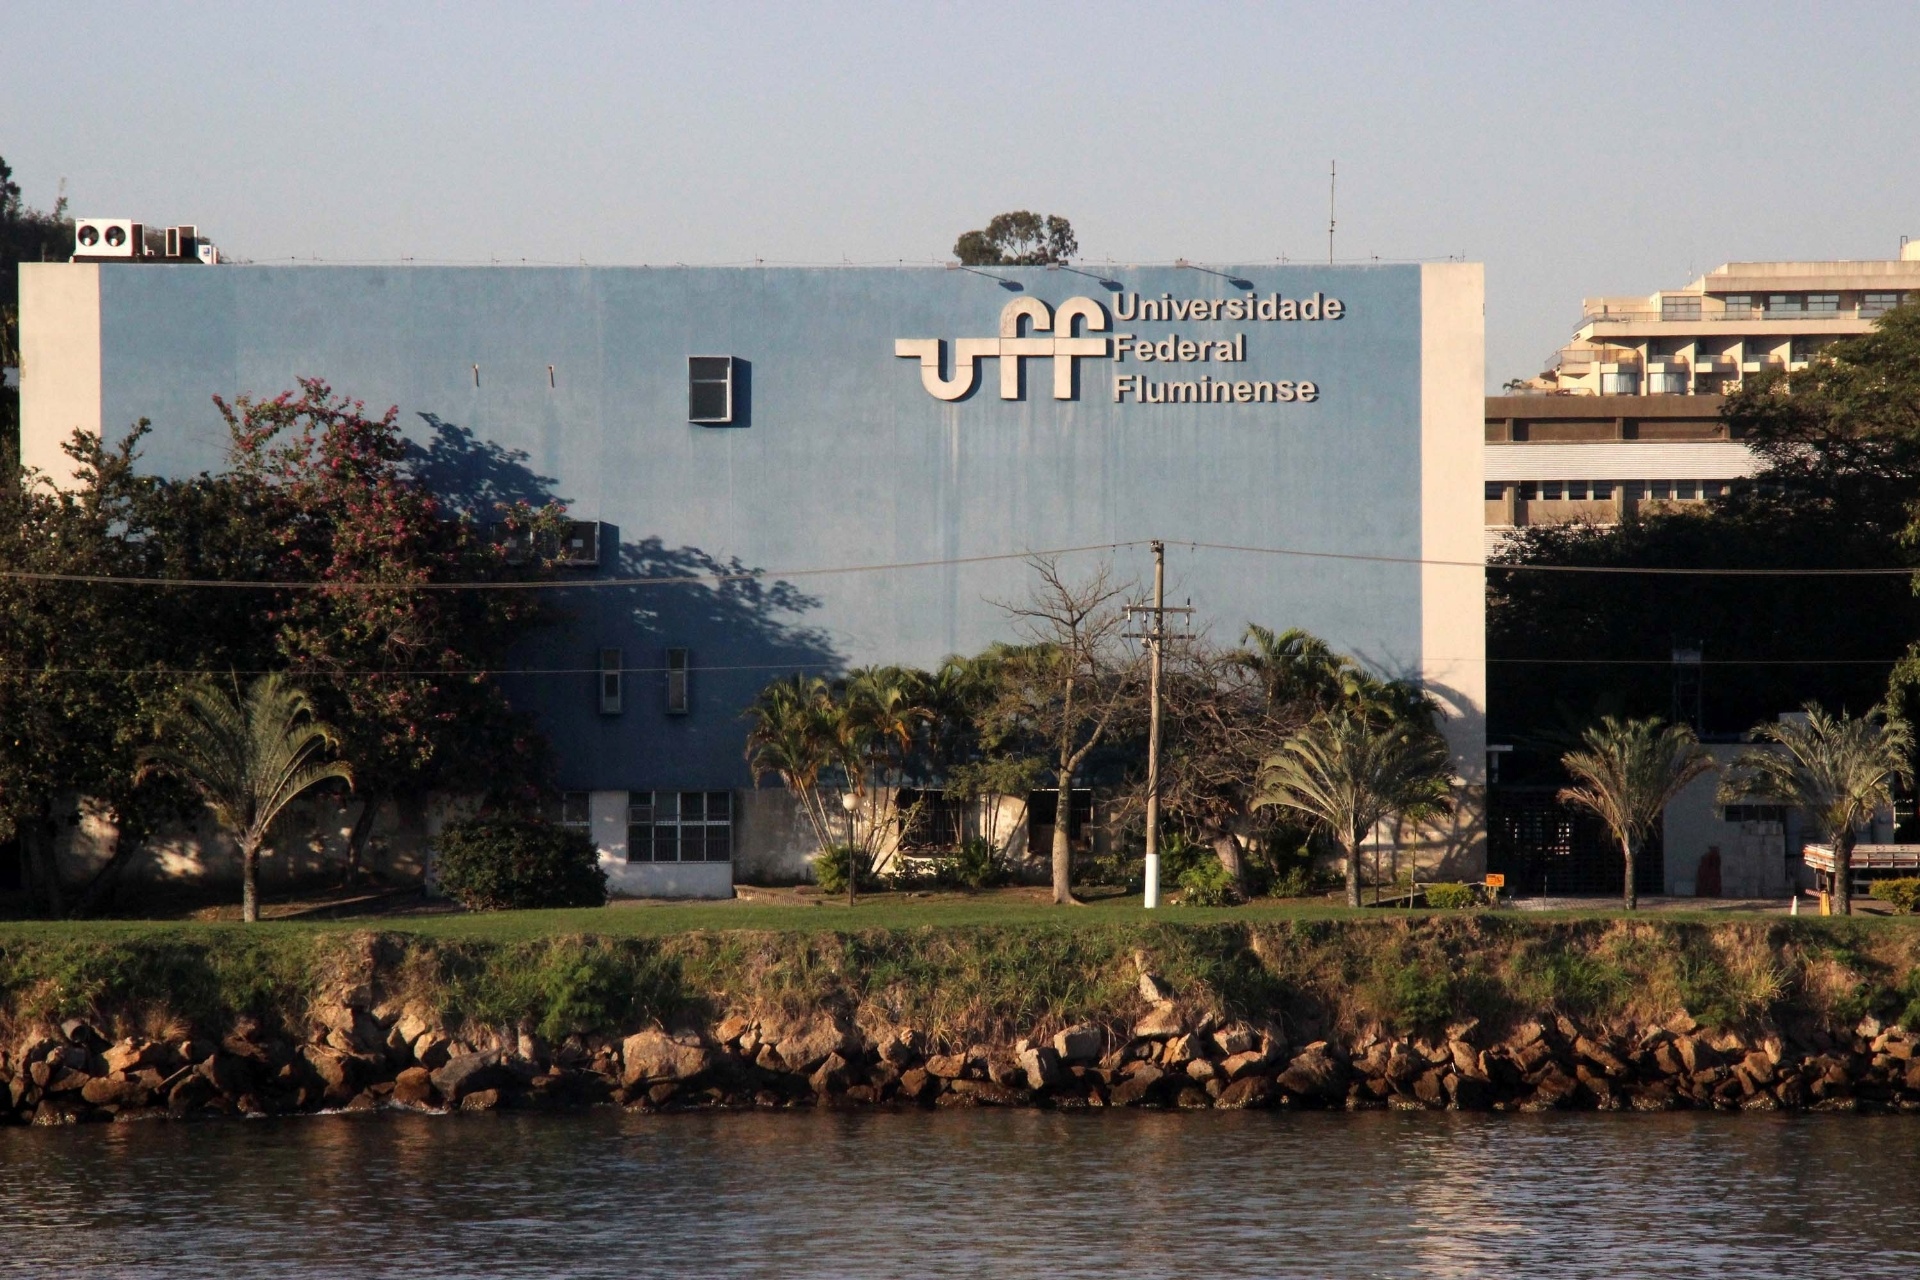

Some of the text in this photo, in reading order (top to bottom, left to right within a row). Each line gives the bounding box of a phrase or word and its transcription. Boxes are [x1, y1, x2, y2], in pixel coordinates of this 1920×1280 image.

[1112, 292, 1344, 321] Universidade
[895, 296, 1107, 400] uff
[1113, 333, 1246, 362] Federal
[1113, 374, 1318, 403] Fluminense
